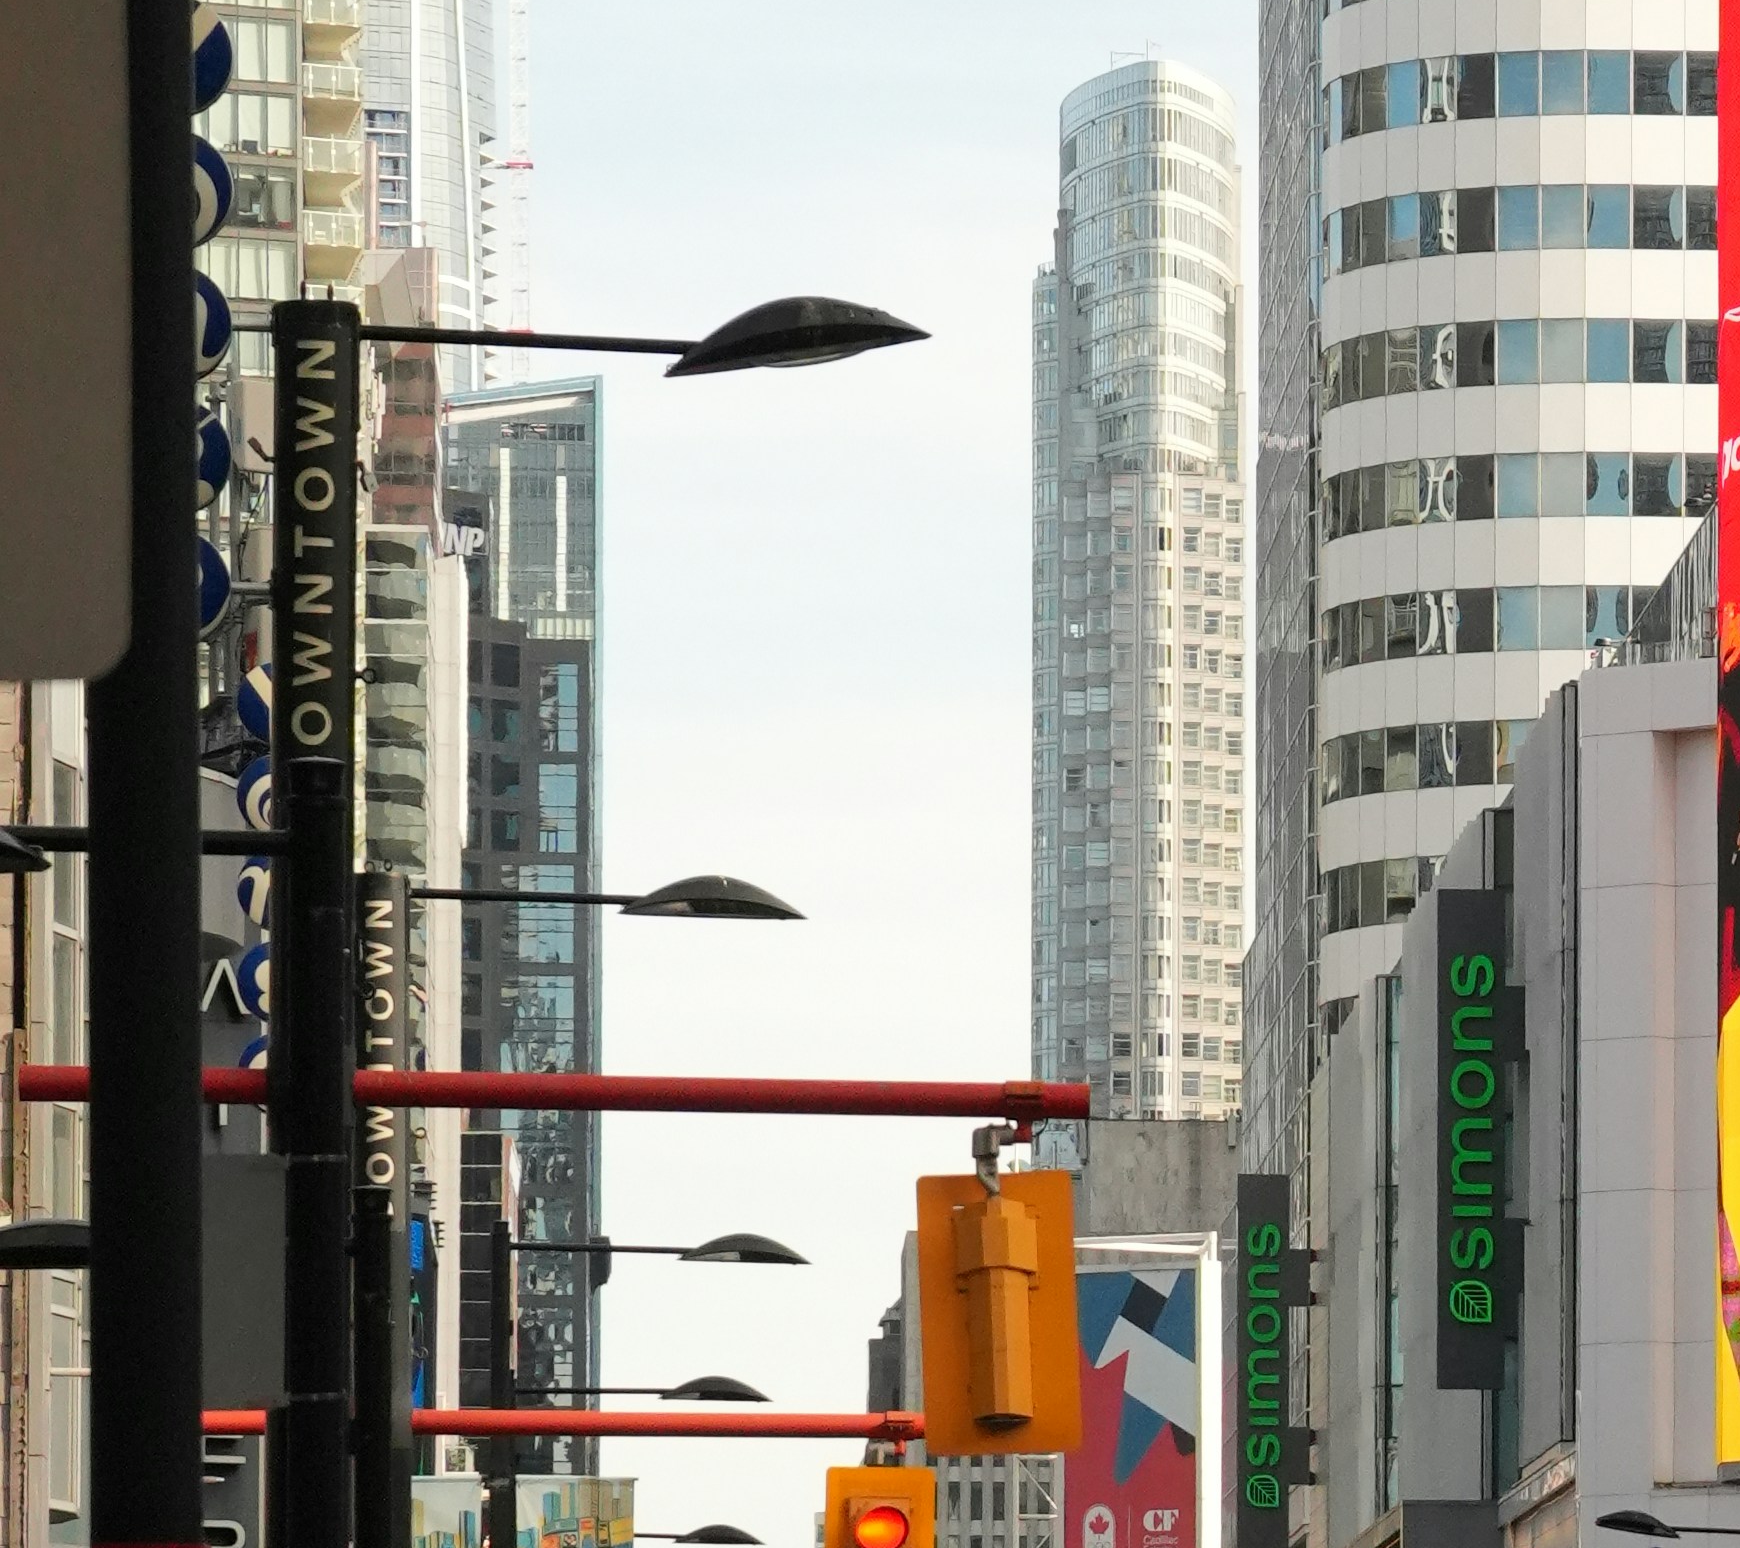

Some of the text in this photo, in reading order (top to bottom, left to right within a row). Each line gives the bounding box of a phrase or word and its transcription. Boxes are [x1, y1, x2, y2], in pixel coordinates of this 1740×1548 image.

[291, 337, 336, 747] OWNTOWN
[364, 898, 396, 1218] OWTOWN
[1449, 953, 1497, 1268] simons
[1247, 1221, 1282, 1467] simons
[1142, 1508, 1180, 1532] CF
